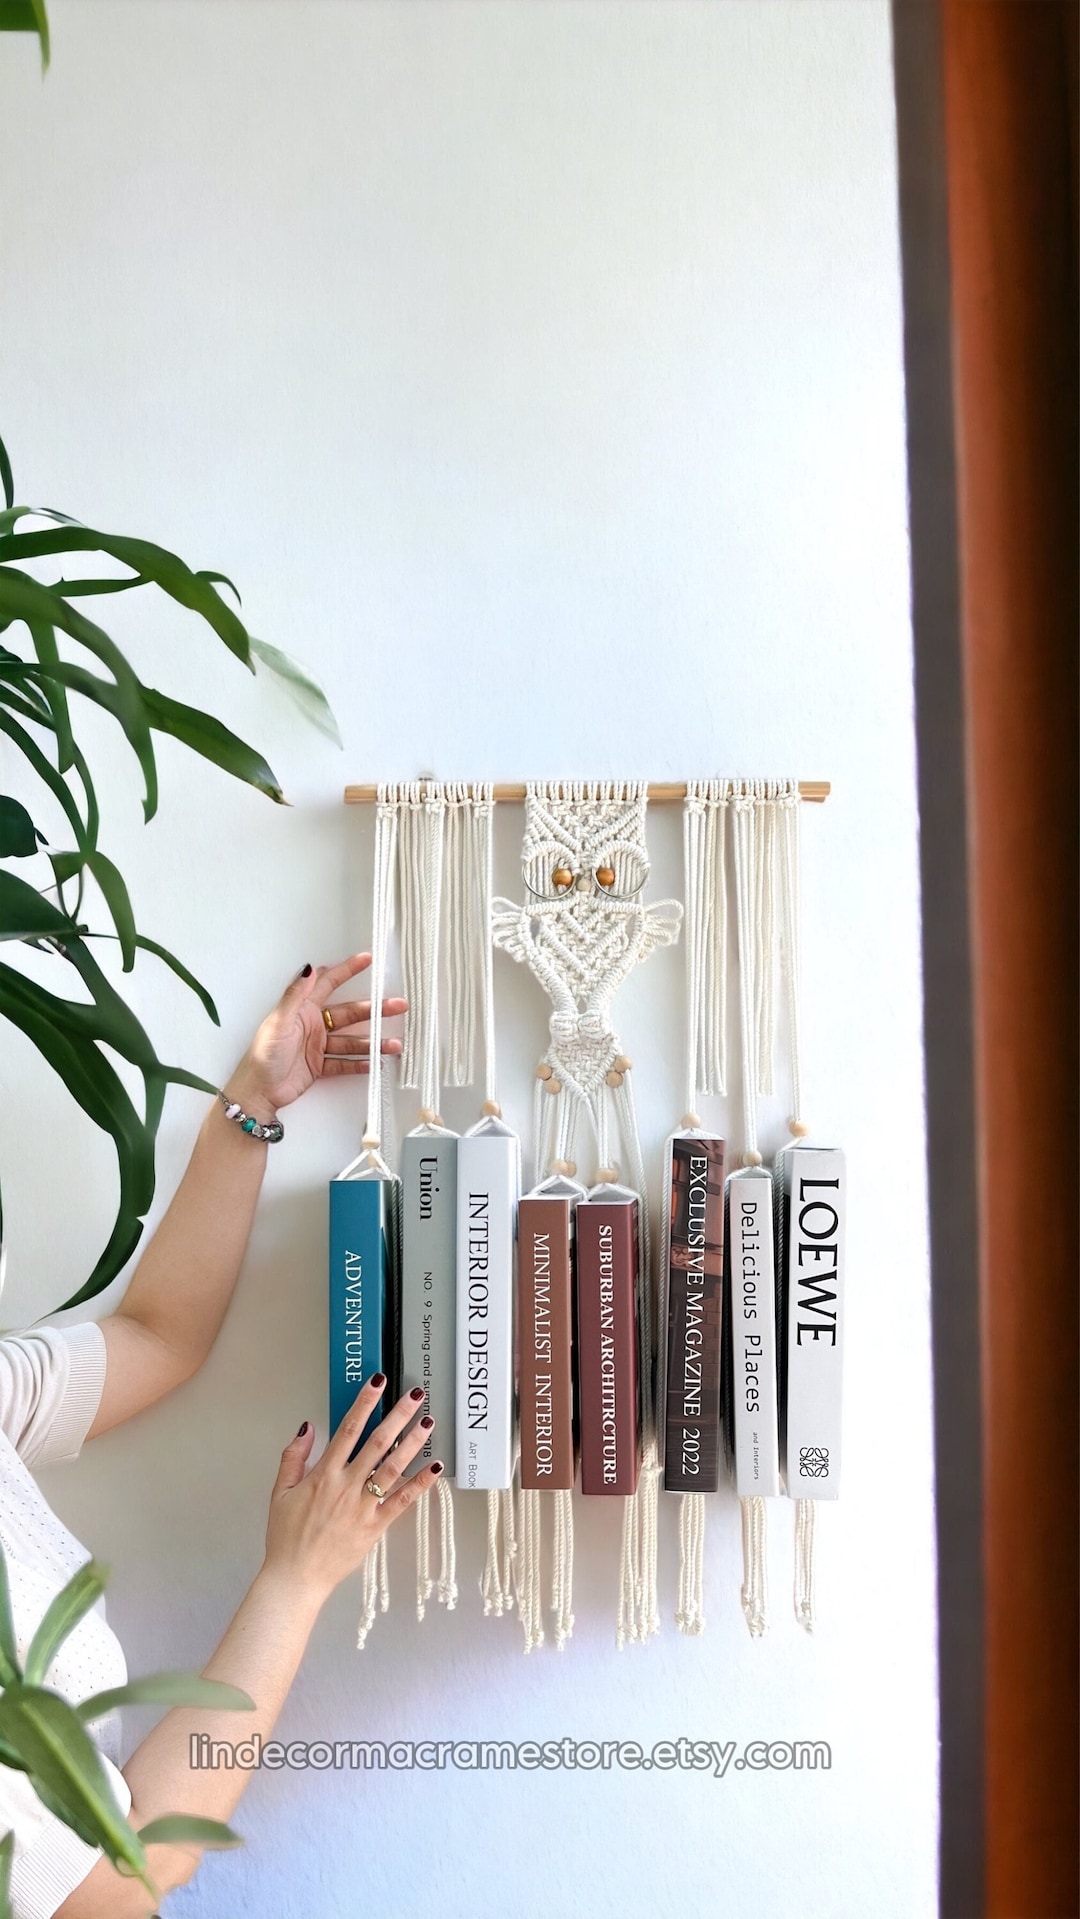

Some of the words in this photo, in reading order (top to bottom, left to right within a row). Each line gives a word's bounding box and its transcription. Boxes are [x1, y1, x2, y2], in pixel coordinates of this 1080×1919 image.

[419, 1156, 440, 1220] Union
[686, 1155, 709, 1286] EXCLUSIVE
[423, 1271, 432, 1297] NO.
[423, 1300, 433, 1308] 9
[468, 1192, 489, 1321] INTERIOR
[533, 1233, 550, 1363] MINIMALIST
[599, 1225, 614, 1330] SUBURBAN
[741, 1202, 760, 1319] Delicious
[797, 1177, 840, 1346] LOEWE
[345, 1250, 362, 1383] ADVENTURE
[421, 1313, 433, 1351] Spring
[423, 1354, 433, 1376] and
[683, 1292, 704, 1417] MAGAZINE
[423, 1380, 431, 1430] summ
[468, 1331, 489, 1431] DESIGN
[744, 1334, 762, 1413] Places
[423, 1433, 432, 1458] 018
[535, 1374, 553, 1476] INTERIOR
[682, 1428, 700, 1476] 2022
